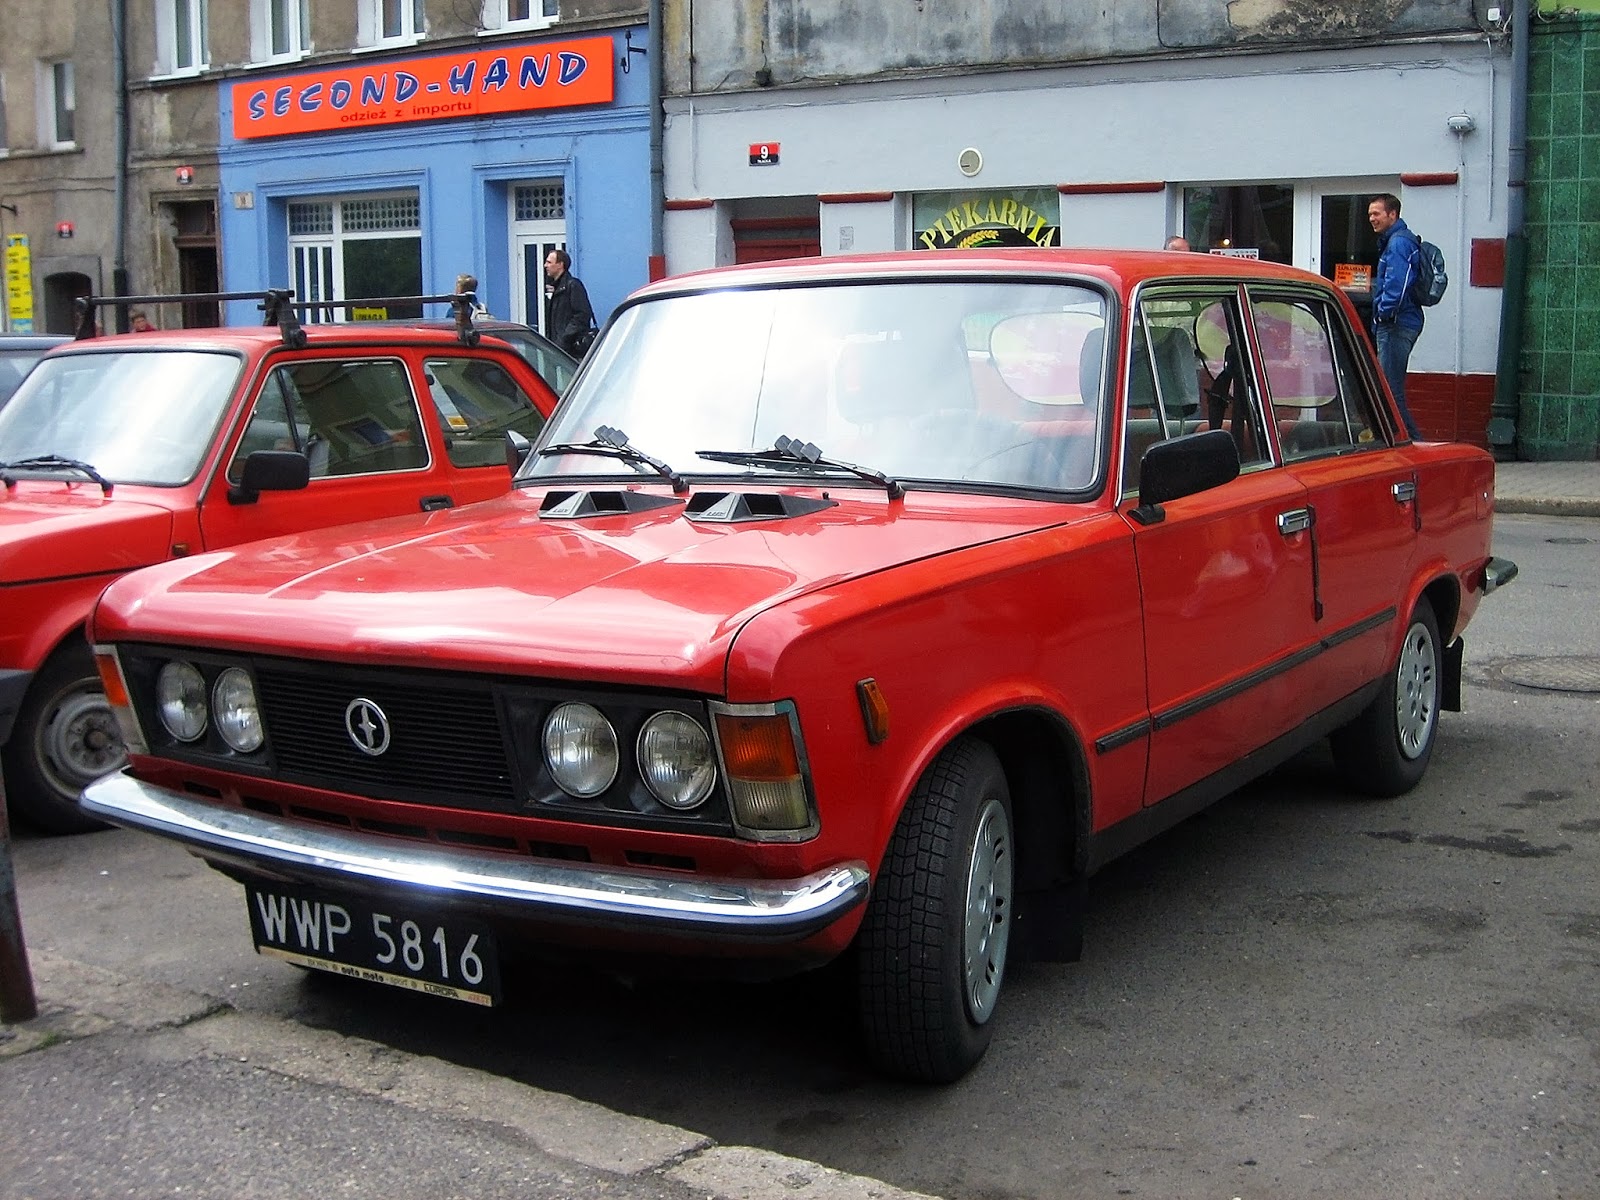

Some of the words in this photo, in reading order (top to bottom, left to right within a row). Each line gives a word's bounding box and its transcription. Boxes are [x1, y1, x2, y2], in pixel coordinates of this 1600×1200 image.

[248, 52, 588, 121] SECOND-HAND
[340, 109, 387, 123] odzież
[394, 109, 403, 117] z
[412, 102, 472, 116] importu
[760, 145, 769, 160] 9
[919, 198, 1056, 249] PIEKARNIA
[256, 892, 351, 953] WWP
[372, 912, 484, 985] 5816
